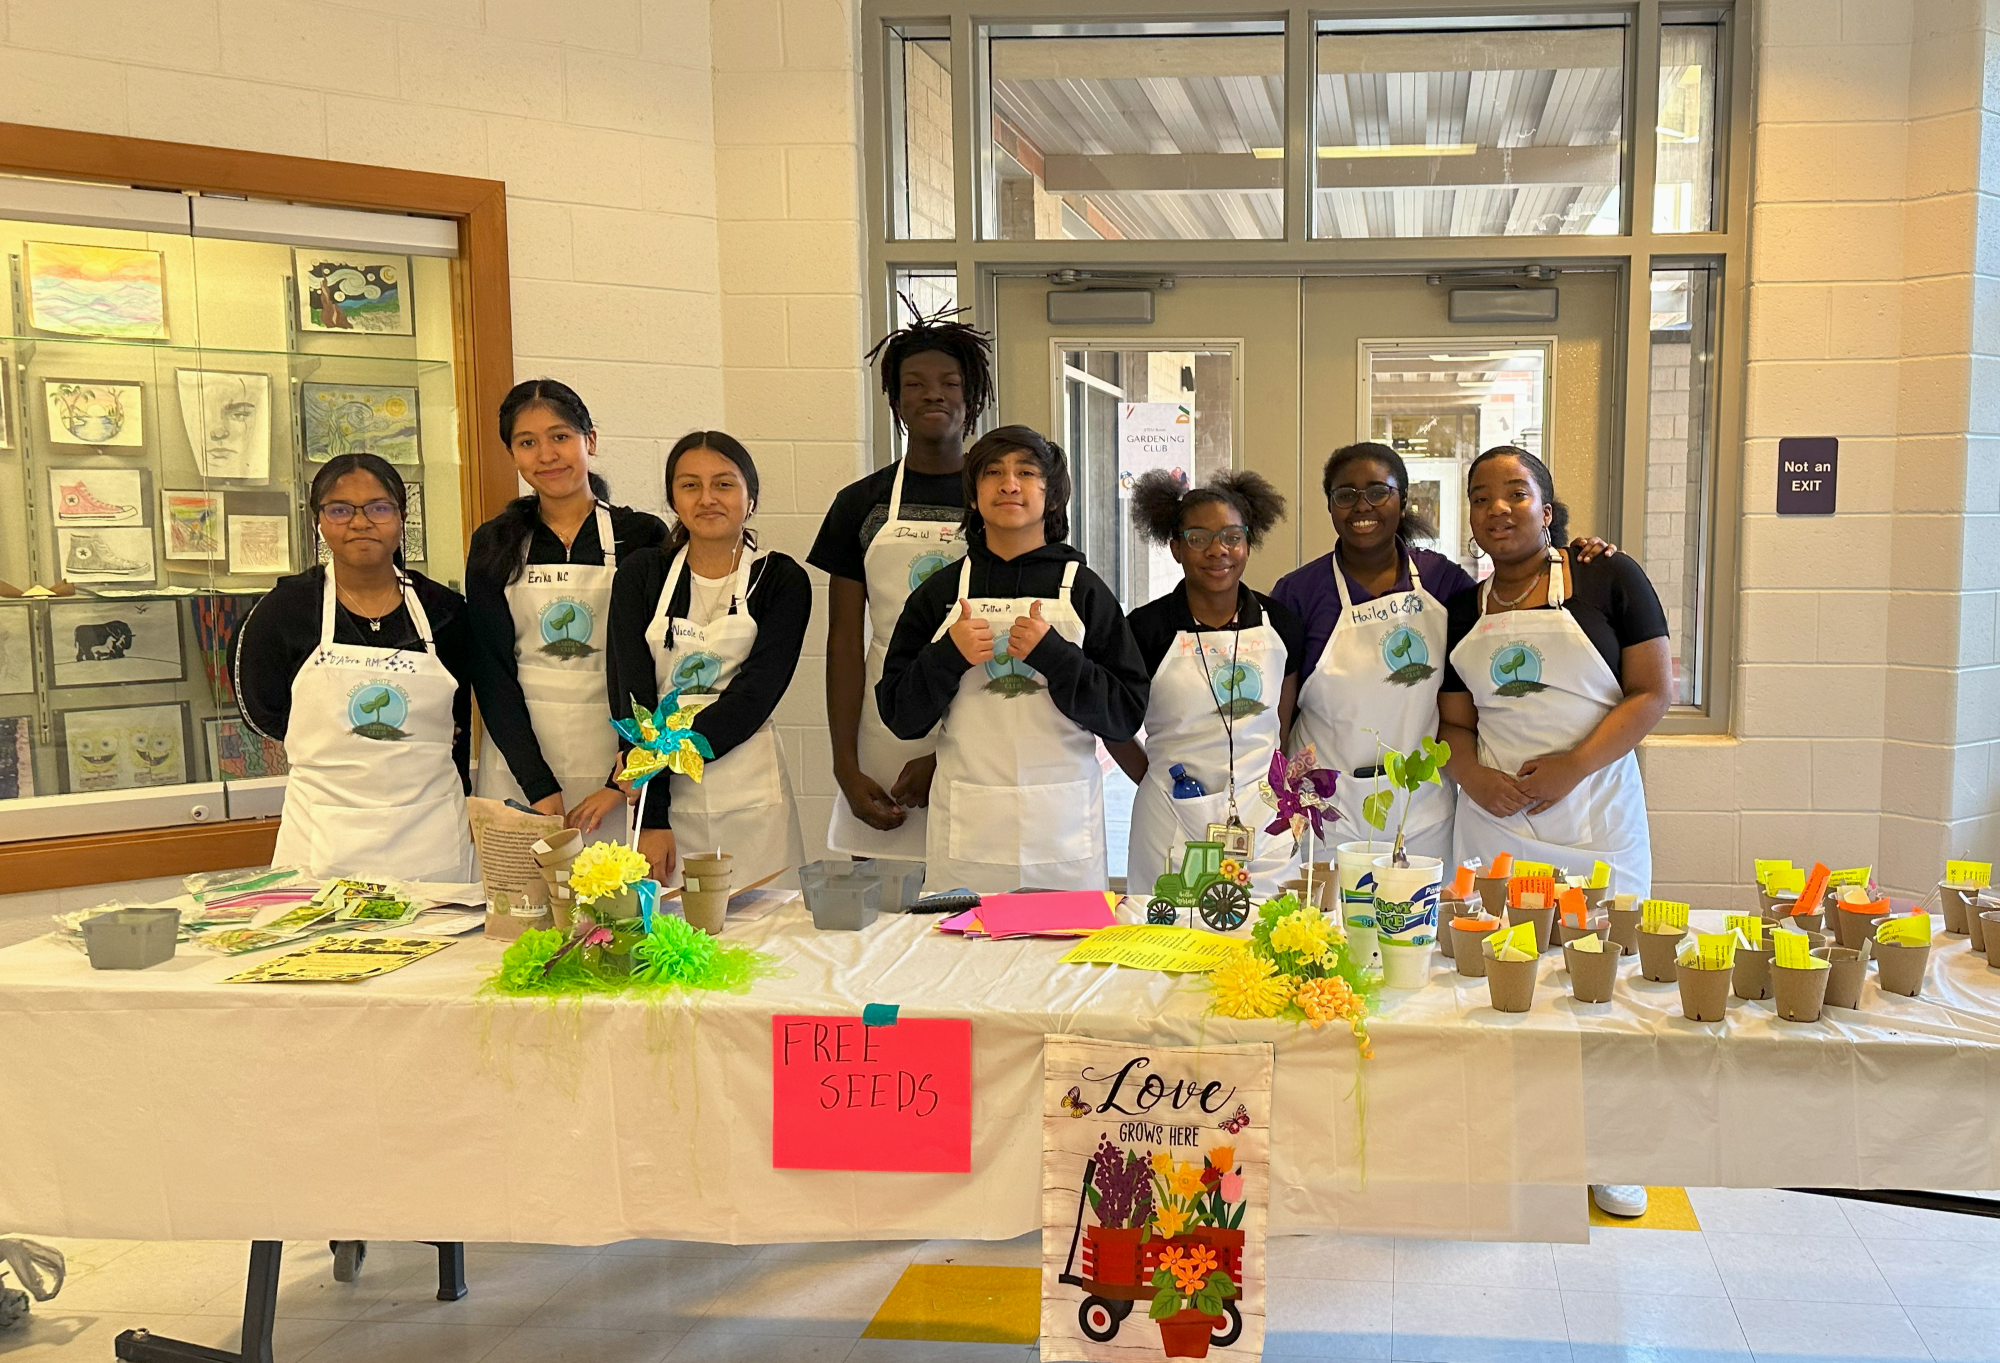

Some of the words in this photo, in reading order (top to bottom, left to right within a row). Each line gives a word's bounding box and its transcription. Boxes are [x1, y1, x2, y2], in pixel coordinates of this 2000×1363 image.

[1127, 435, 1184, 443] GARDENING
[1784, 461, 1808, 472] Not
[1815, 463, 1831, 472] an
[1792, 480, 1822, 491] EXIT
[528, 571, 551, 584] Erika
[673, 624, 696, 638] Nicole
[346, 681, 365, 698] EDDIE
[368, 678, 392, 686] WHITE
[396, 684, 412, 703] MIDDLE
[785, 1023, 880, 1065] FREE
[820, 1071, 938, 1117] SEEDS
[1082, 1057, 1236, 1115] Love
[1119, 1122, 1163, 1145] GROWS
[1169, 1126, 1199, 1147] HERE
